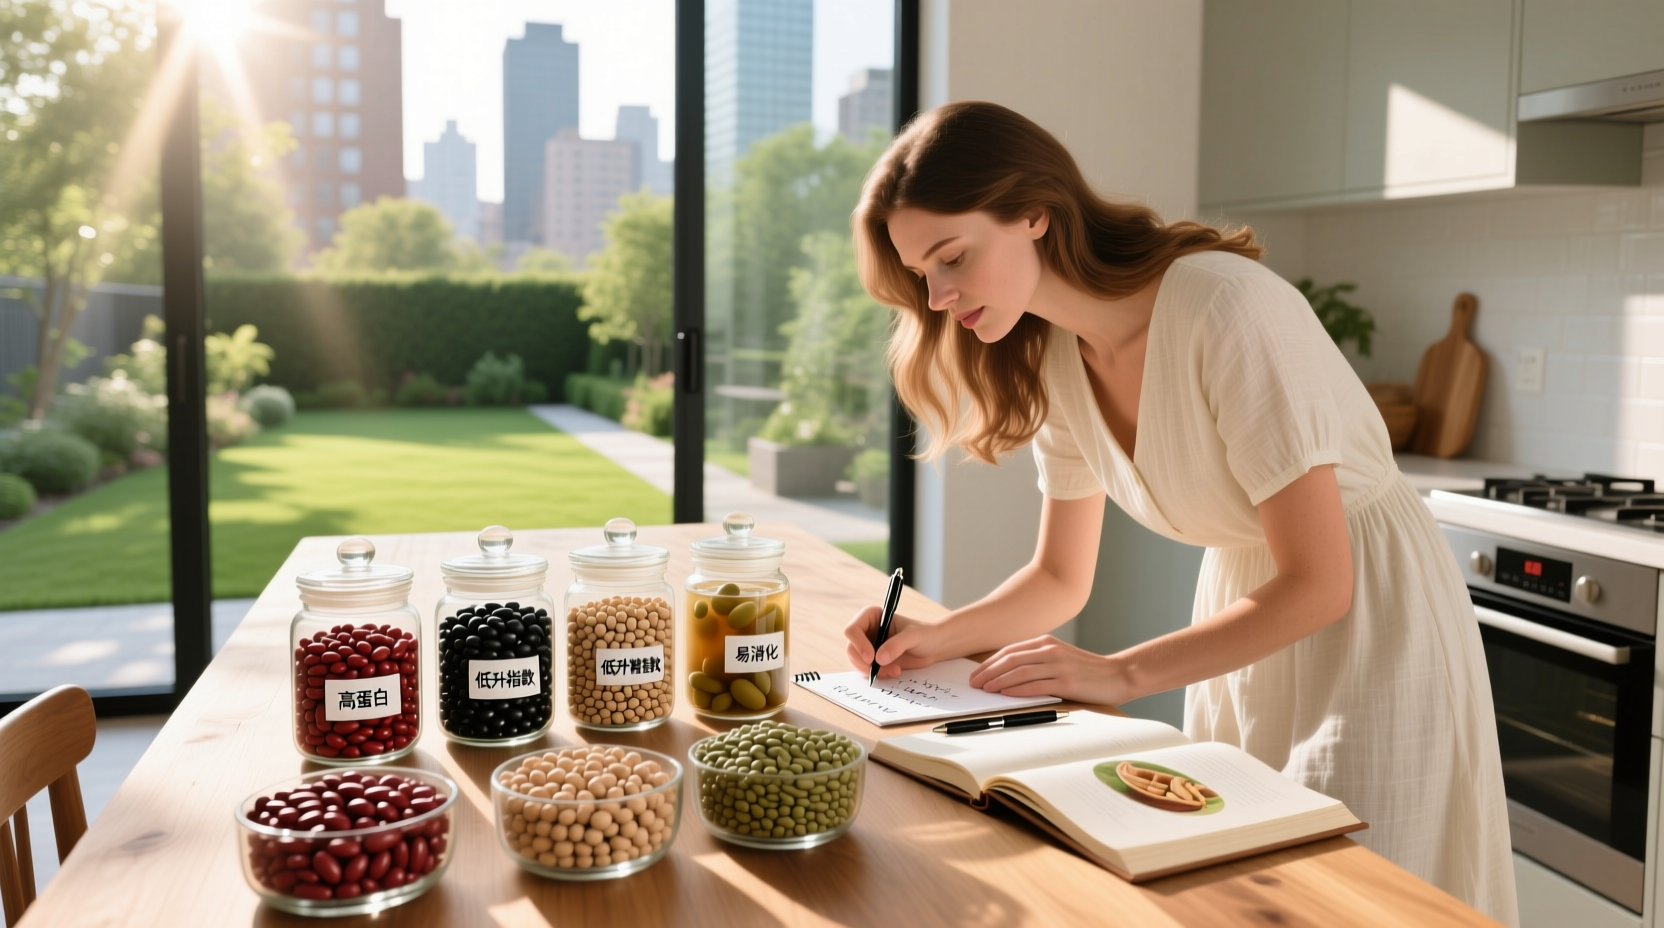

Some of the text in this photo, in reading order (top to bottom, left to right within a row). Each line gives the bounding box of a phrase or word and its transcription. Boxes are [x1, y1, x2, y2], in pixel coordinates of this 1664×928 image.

[735, 643, 778, 663] 易消化
[338, 688, 388, 711] 高蛋白
